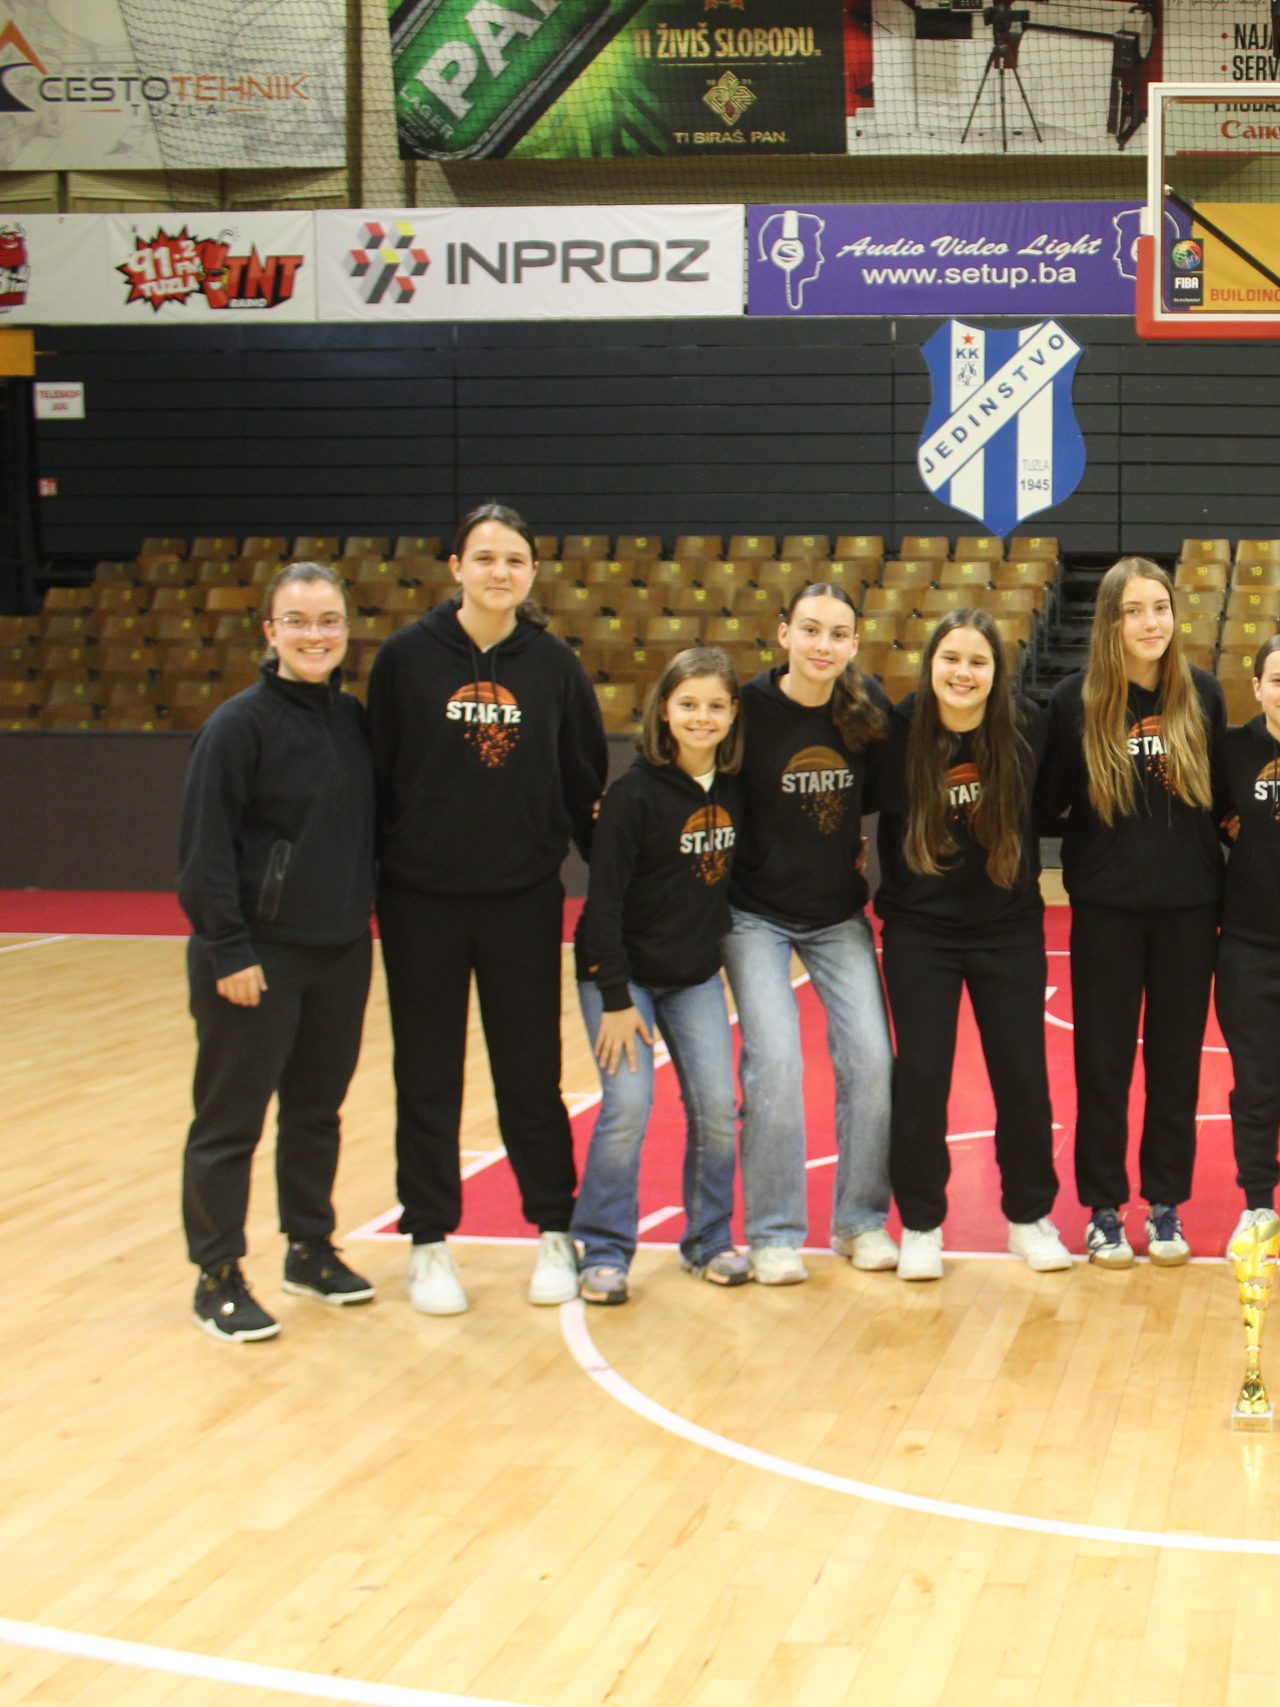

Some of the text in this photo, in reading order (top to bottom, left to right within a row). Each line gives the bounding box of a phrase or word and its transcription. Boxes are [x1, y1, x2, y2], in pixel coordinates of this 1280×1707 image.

[632, 21, 822, 59] TI ŽIVIŠ SLOBODU.
[38, 73, 310, 102] CESTOTEHNIK
[131, 103, 219, 117] TUZLA
[673, 132, 689, 144] TI
[750, 131, 790, 144] PAN.
[836, 233, 1103, 261] Audio Video Light
[225, 241, 304, 300] TNT
[446, 239, 711, 285] INPROZ
[861, 261, 1077, 289] www.setup.ba
[1174, 276, 1200, 290] FIBA
[955, 347, 980, 360] KK
[923, 333, 1066, 474] JEDINSTVO
[1021, 458, 1050, 472] TUZLA
[1019, 479, 1050, 491] 1945
[1030, 537, 1041, 549] 17
